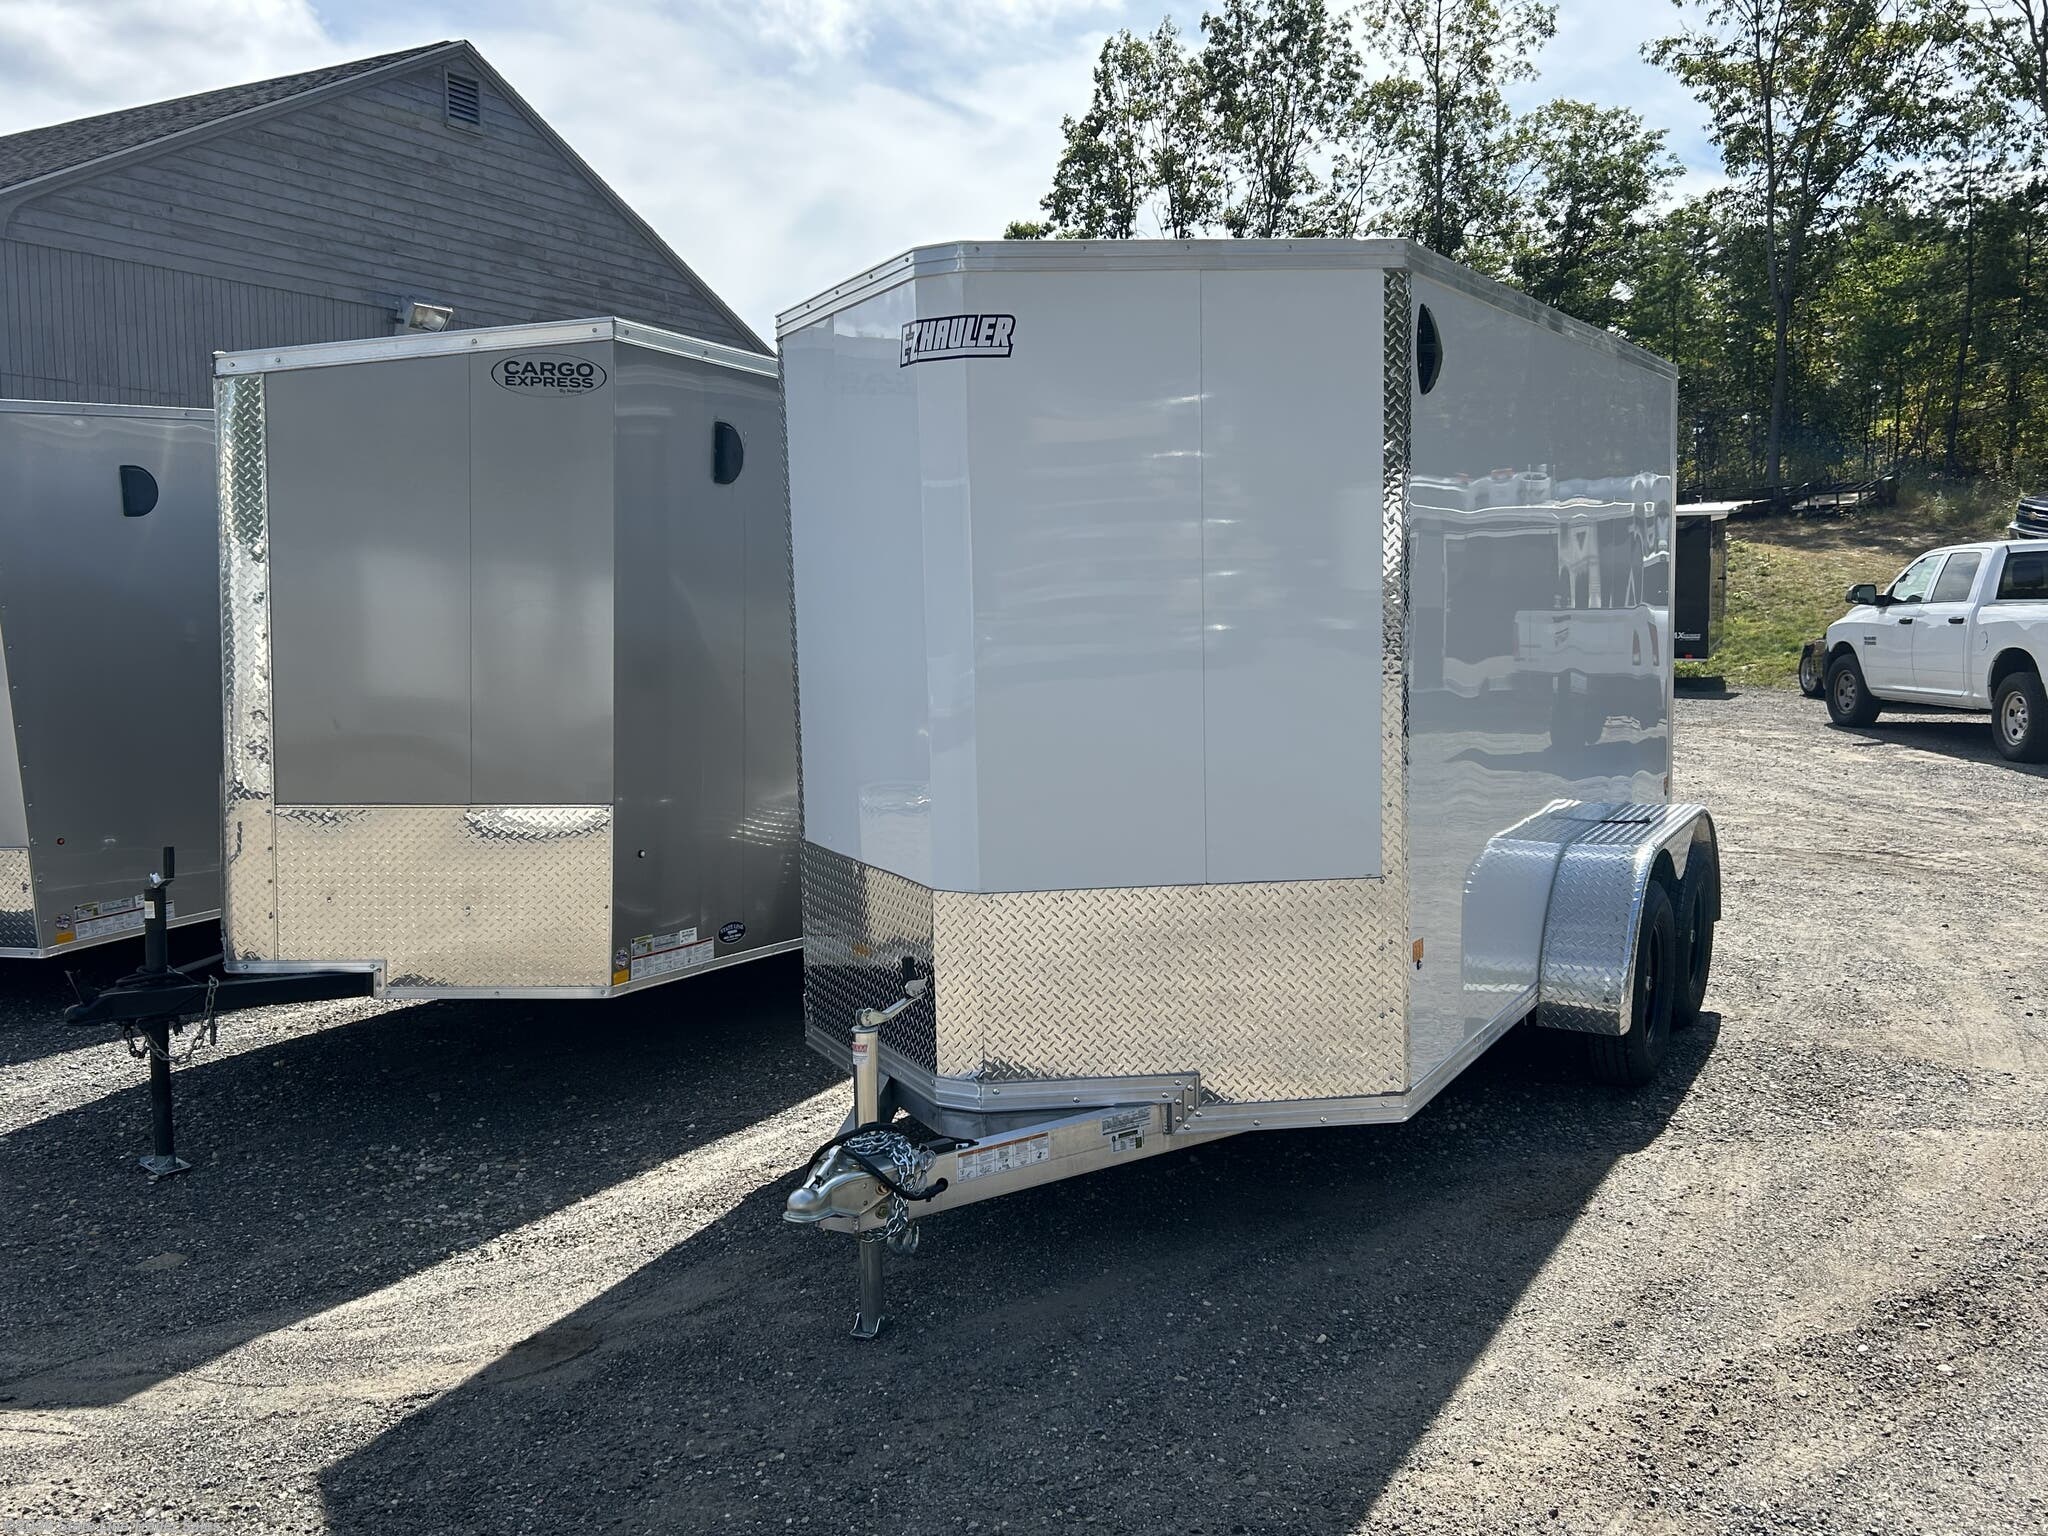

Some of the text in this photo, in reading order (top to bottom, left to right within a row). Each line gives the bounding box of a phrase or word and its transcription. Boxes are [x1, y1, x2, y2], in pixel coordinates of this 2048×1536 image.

[919, 316, 1014, 352] HAULER
[504, 361, 594, 377] CARGO
[505, 376, 594, 388] EXPRESS
